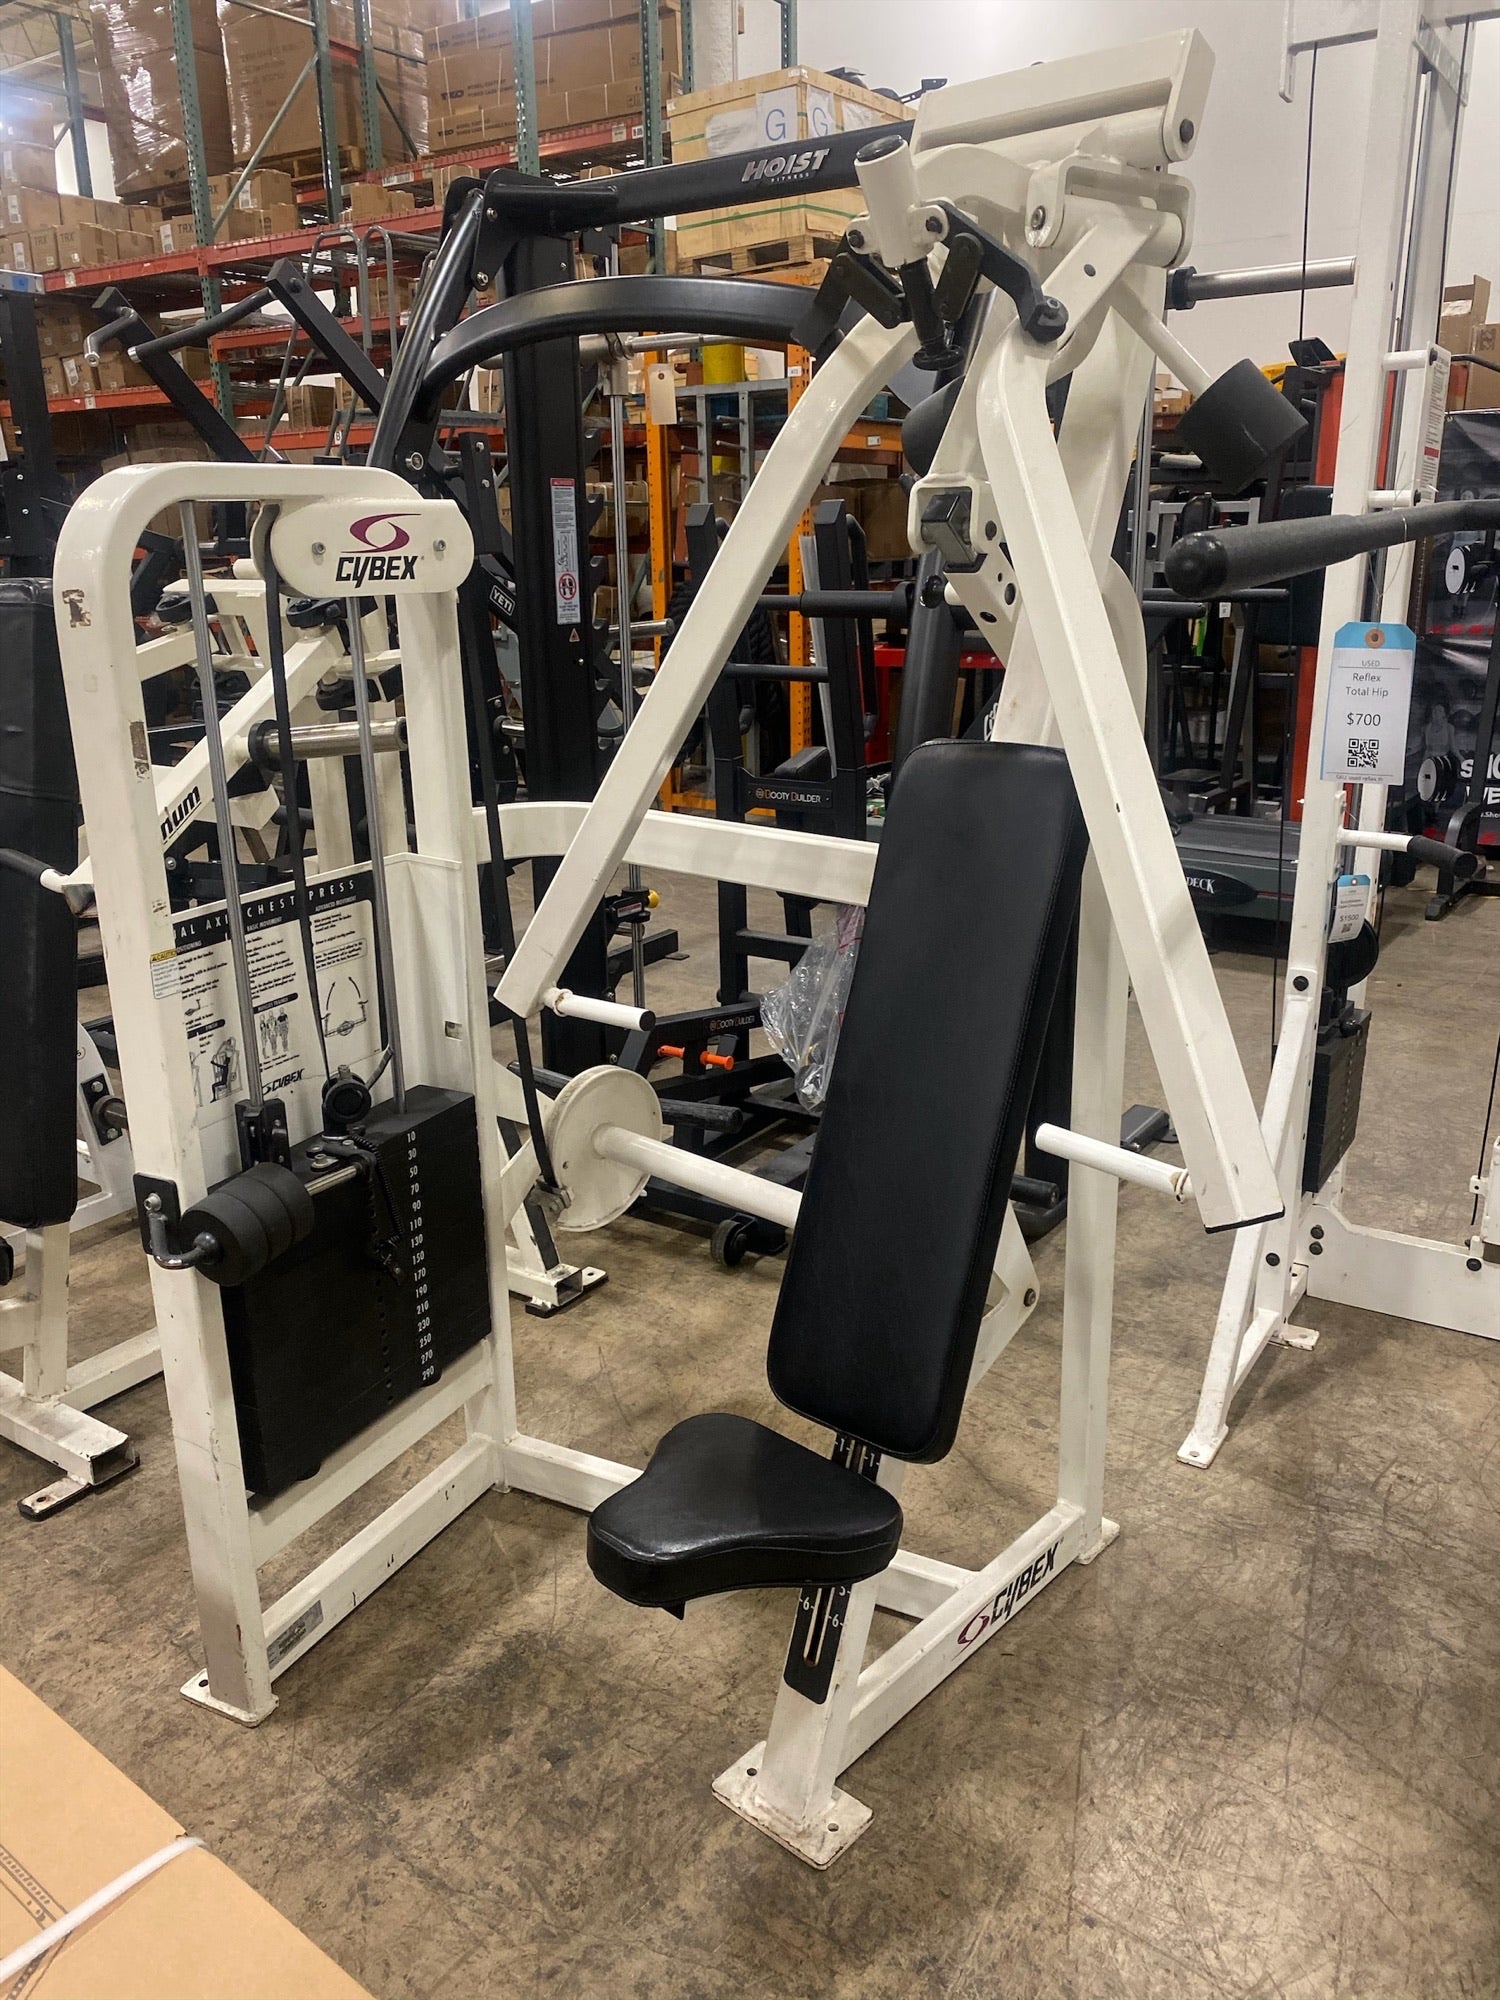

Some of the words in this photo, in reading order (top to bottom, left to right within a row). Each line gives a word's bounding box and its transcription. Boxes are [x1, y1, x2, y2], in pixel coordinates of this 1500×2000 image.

[765, 108, 786, 141] G
[812, 107, 829, 137] G
[741, 148, 830, 182] HOIST
[207, 184, 218, 195] RX
[176, 222, 194, 234] TRX
[335, 555, 418, 589] CYBEX
[494, 589, 512, 612] YETI
[1352, 672, 1381, 683] Reflex
[1345, 686, 1369, 697] Total
[1371, 686, 1389, 699] Hip
[1346, 712, 1381, 727] $700
[206, 914, 229, 930] AXI
[247, 895, 295, 918] CHEST
[308, 879, 354, 901] PRESS
[271, 1067, 305, 1091] CYBEX
[407, 1130, 416, 1143] 10
[408, 1147, 417, 1160] 30
[409, 1165, 418, 1178] 50
[410, 1182, 419, 1195] 70
[412, 1199, 421, 1212] 90
[410, 1216, 422, 1231] 110
[411, 1233, 423, 1248] 130
[412, 1250, 425, 1265] 150
[414, 1267, 426, 1281] 170
[415, 1283, 428, 1298] 190
[416, 1300, 429, 1315] 210
[417, 1316, 431, 1332] 230
[419, 1332, 432, 1348] 250
[990, 1541, 1061, 1625] CYBEX
[803, 1597, 810, 1611] 6
[831, 1613, 839, 1628] 6
